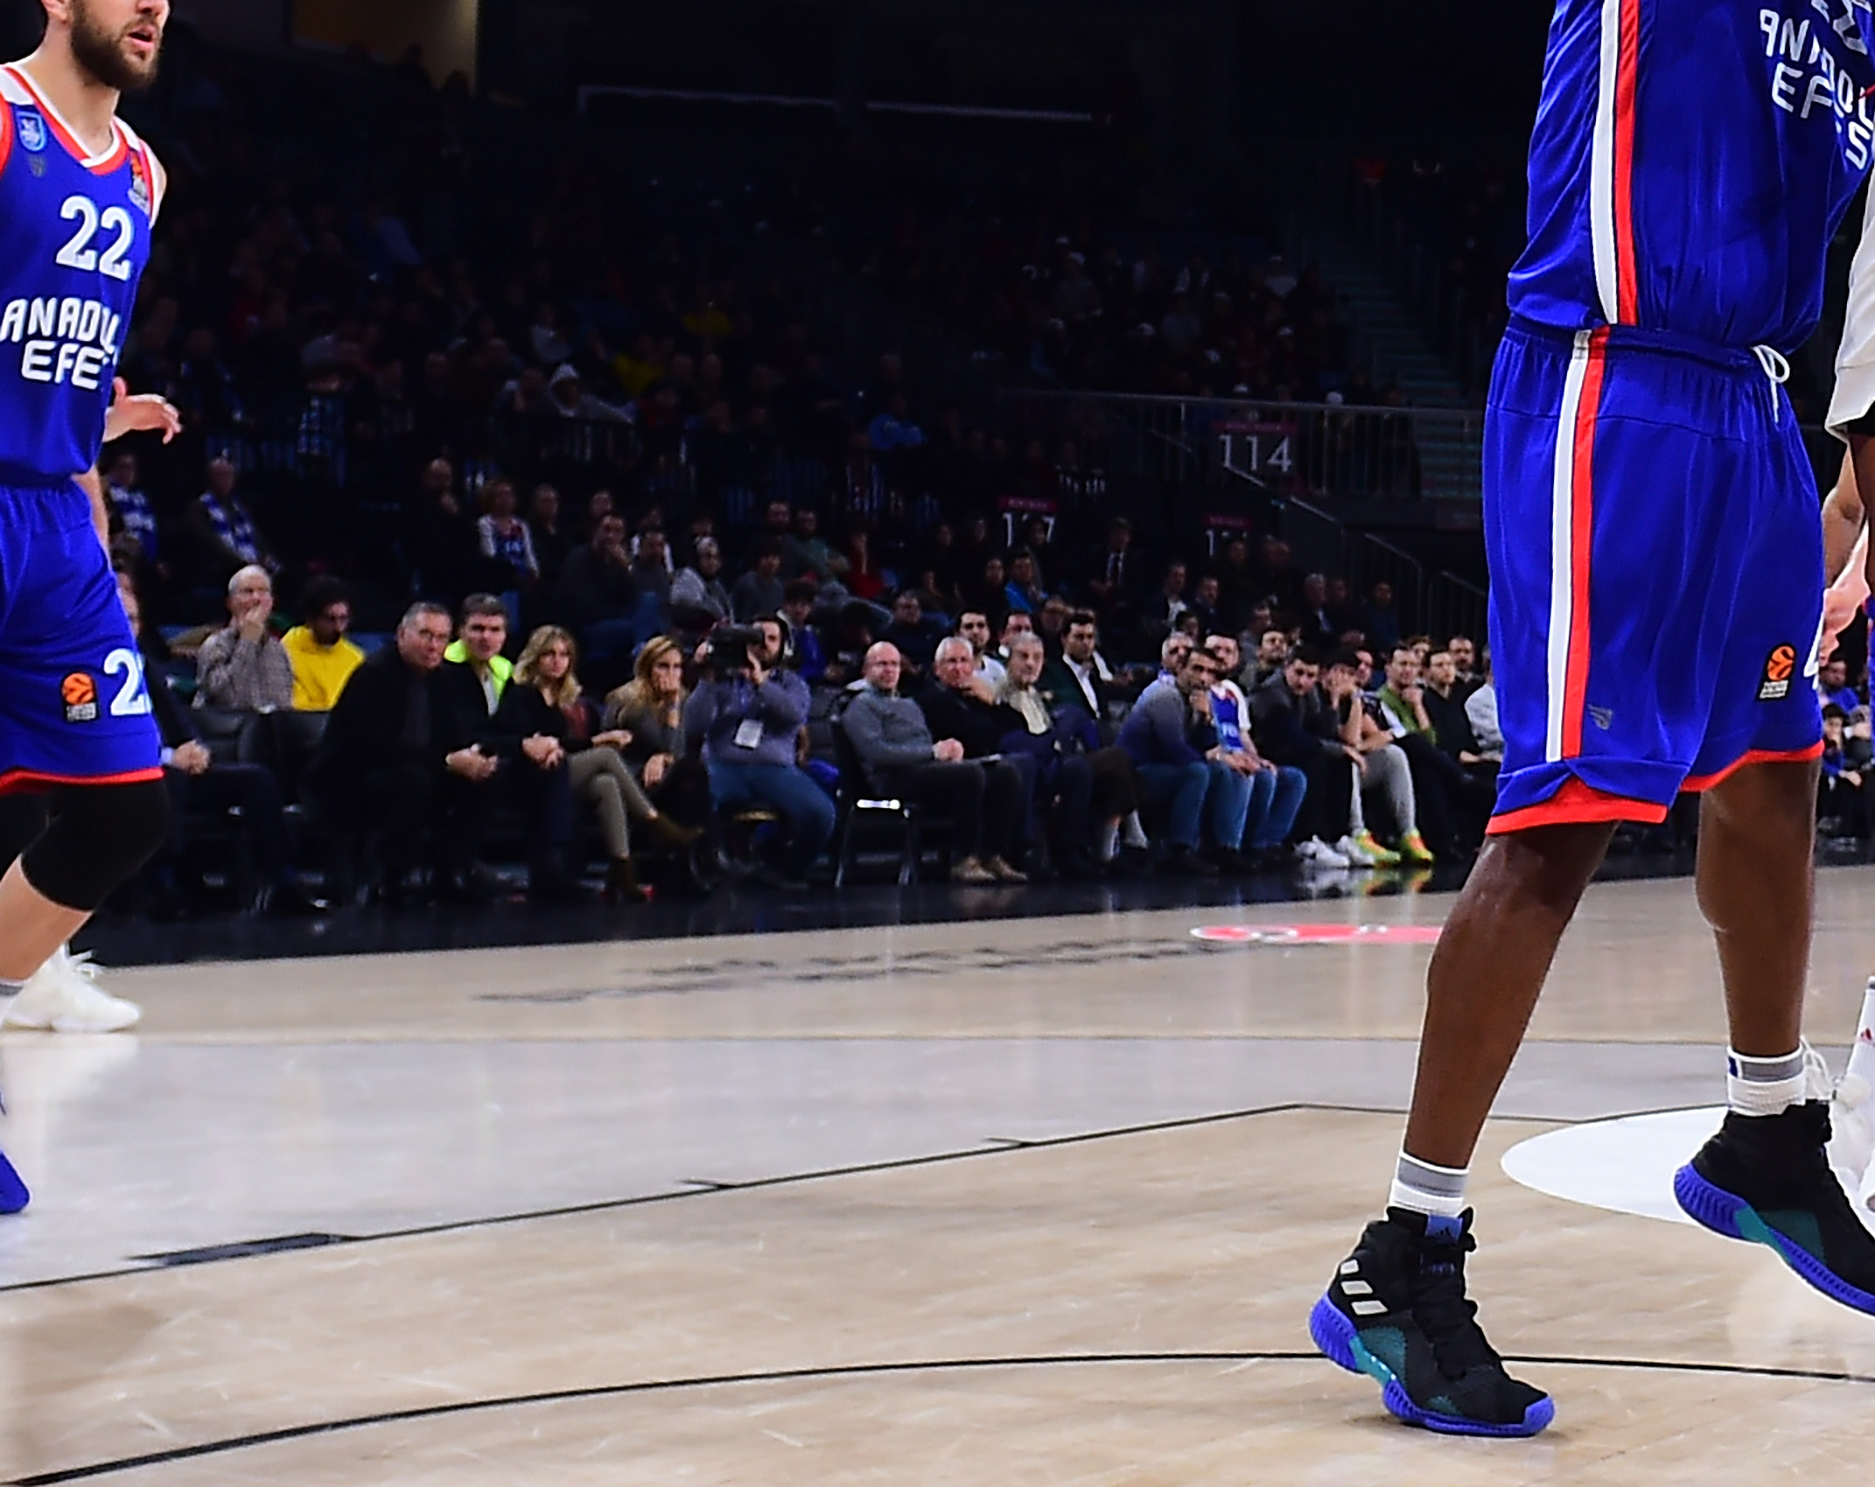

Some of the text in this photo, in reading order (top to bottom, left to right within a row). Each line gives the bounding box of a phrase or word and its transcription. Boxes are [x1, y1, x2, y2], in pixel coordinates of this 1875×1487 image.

[55, 195, 134, 281] 22
[21, 339, 118, 390] EFE
[1218, 433, 1293, 473] 114
[1002, 512, 1057, 549] 17
